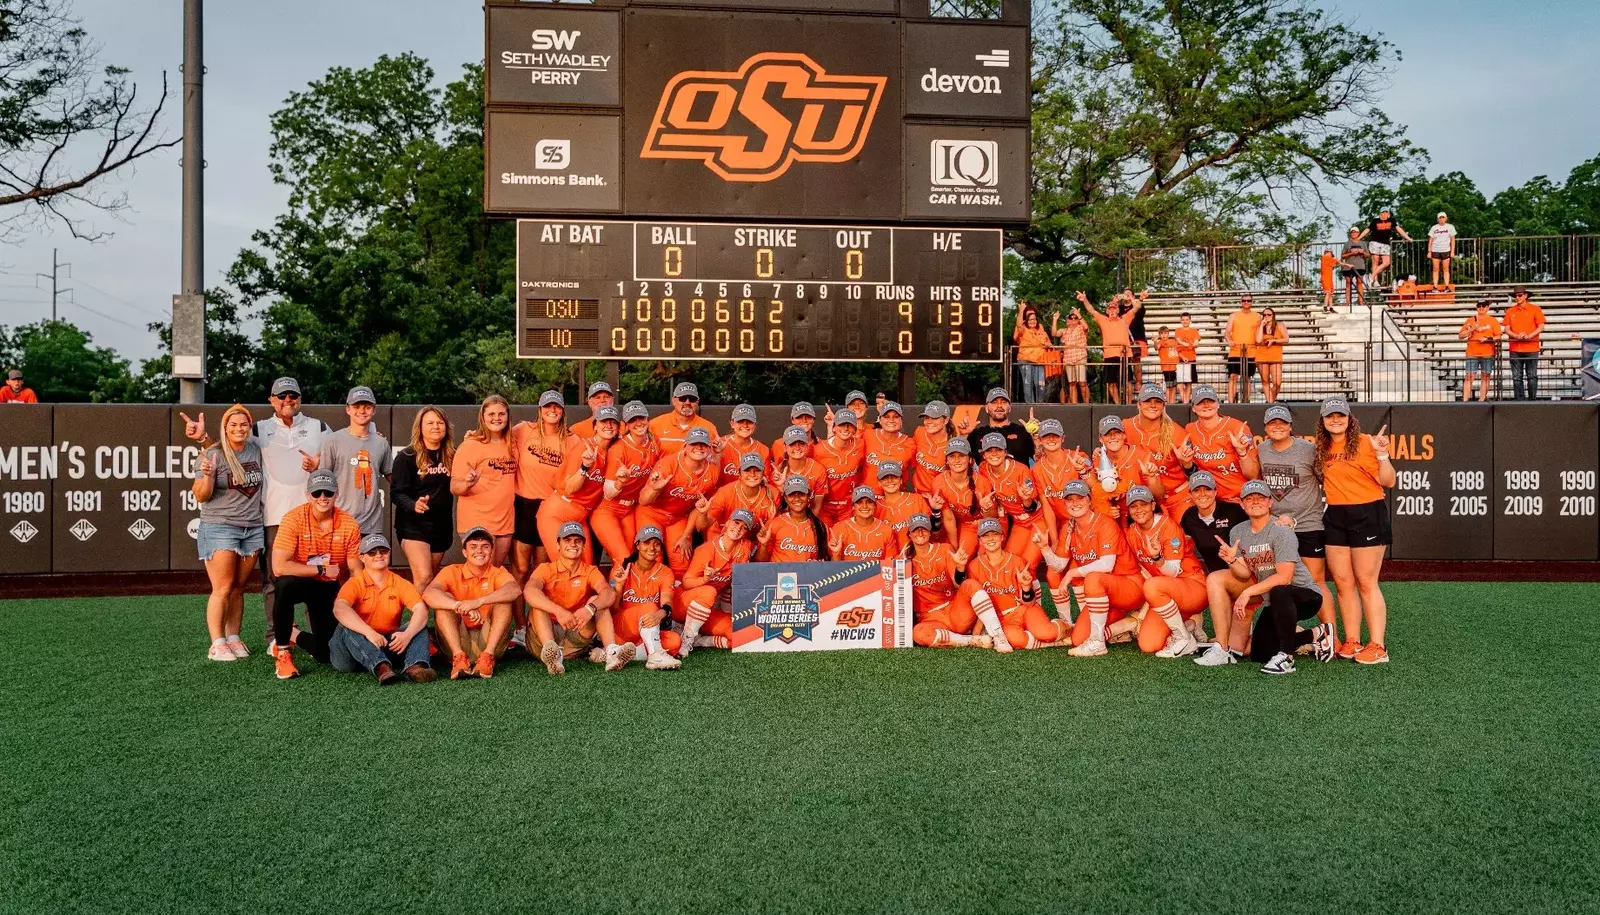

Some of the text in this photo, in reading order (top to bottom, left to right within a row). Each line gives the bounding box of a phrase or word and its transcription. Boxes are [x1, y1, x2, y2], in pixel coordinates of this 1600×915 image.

[532, 29, 581, 50] SW
[501, 51, 611, 67] SETH WADLEY
[532, 71, 581, 85] PERRY
[920, 68, 1002, 94] devon
[940, 145, 992, 186] IQ
[501, 172, 608, 186] Simmons Bank.
[929, 194, 1002, 206] CAR WASH.
[540, 224, 604, 244] AT BAT
[652, 226, 696, 245] BALL
[734, 228, 796, 247] STRIKE
[836, 230, 872, 249] OUT
[932, 232, 962, 252] H/E
[665, 246, 682, 276] 0
[756, 248, 773, 278] 0
[846, 250, 863, 279] 0
[617, 282, 999, 301] 1 2 3 4 5 6 7 8 9 10 RUNS HITS ERR
[546, 299, 579, 318] OSU
[636, 298, 651, 322] 0
[661, 299, 676, 322] 0
[691, 299, 706, 323] 0
[715, 299, 730, 323] 6
[740, 299, 754, 323] 0
[769, 300, 783, 324] 2
[898, 302, 912, 324] 9
[937, 302, 962, 325] 13
[978, 303, 992, 326] 0
[550, 329, 572, 348] UO
[612, 327, 626, 351] 0
[636, 328, 651, 351] 0
[661, 328, 676, 351] 0
[691, 328, 706, 352] 0
[715, 328, 730, 352] 0
[740, 329, 754, 352] 0
[769, 329, 783, 353] 0
[898, 330, 913, 354] 0
[948, 331, 962, 354] 2
[95, 446, 200, 479] COLLEG
[1397, 471, 1595, 490] 1984 1988 1989 1990
[3, 492, 45, 513] 1980
[65, 490, 101, 511] 1981
[122, 490, 161, 511] 1982
[1397, 496, 1595, 515] 2003 2005 2009 2010
[882, 566, 893, 579] 23
[758, 613, 818, 624] WORLD SERIES
[770, 604, 806, 614] COLLEGE
[836, 606, 875, 628] OSU
[831, 628, 876, 640] #WCWS
